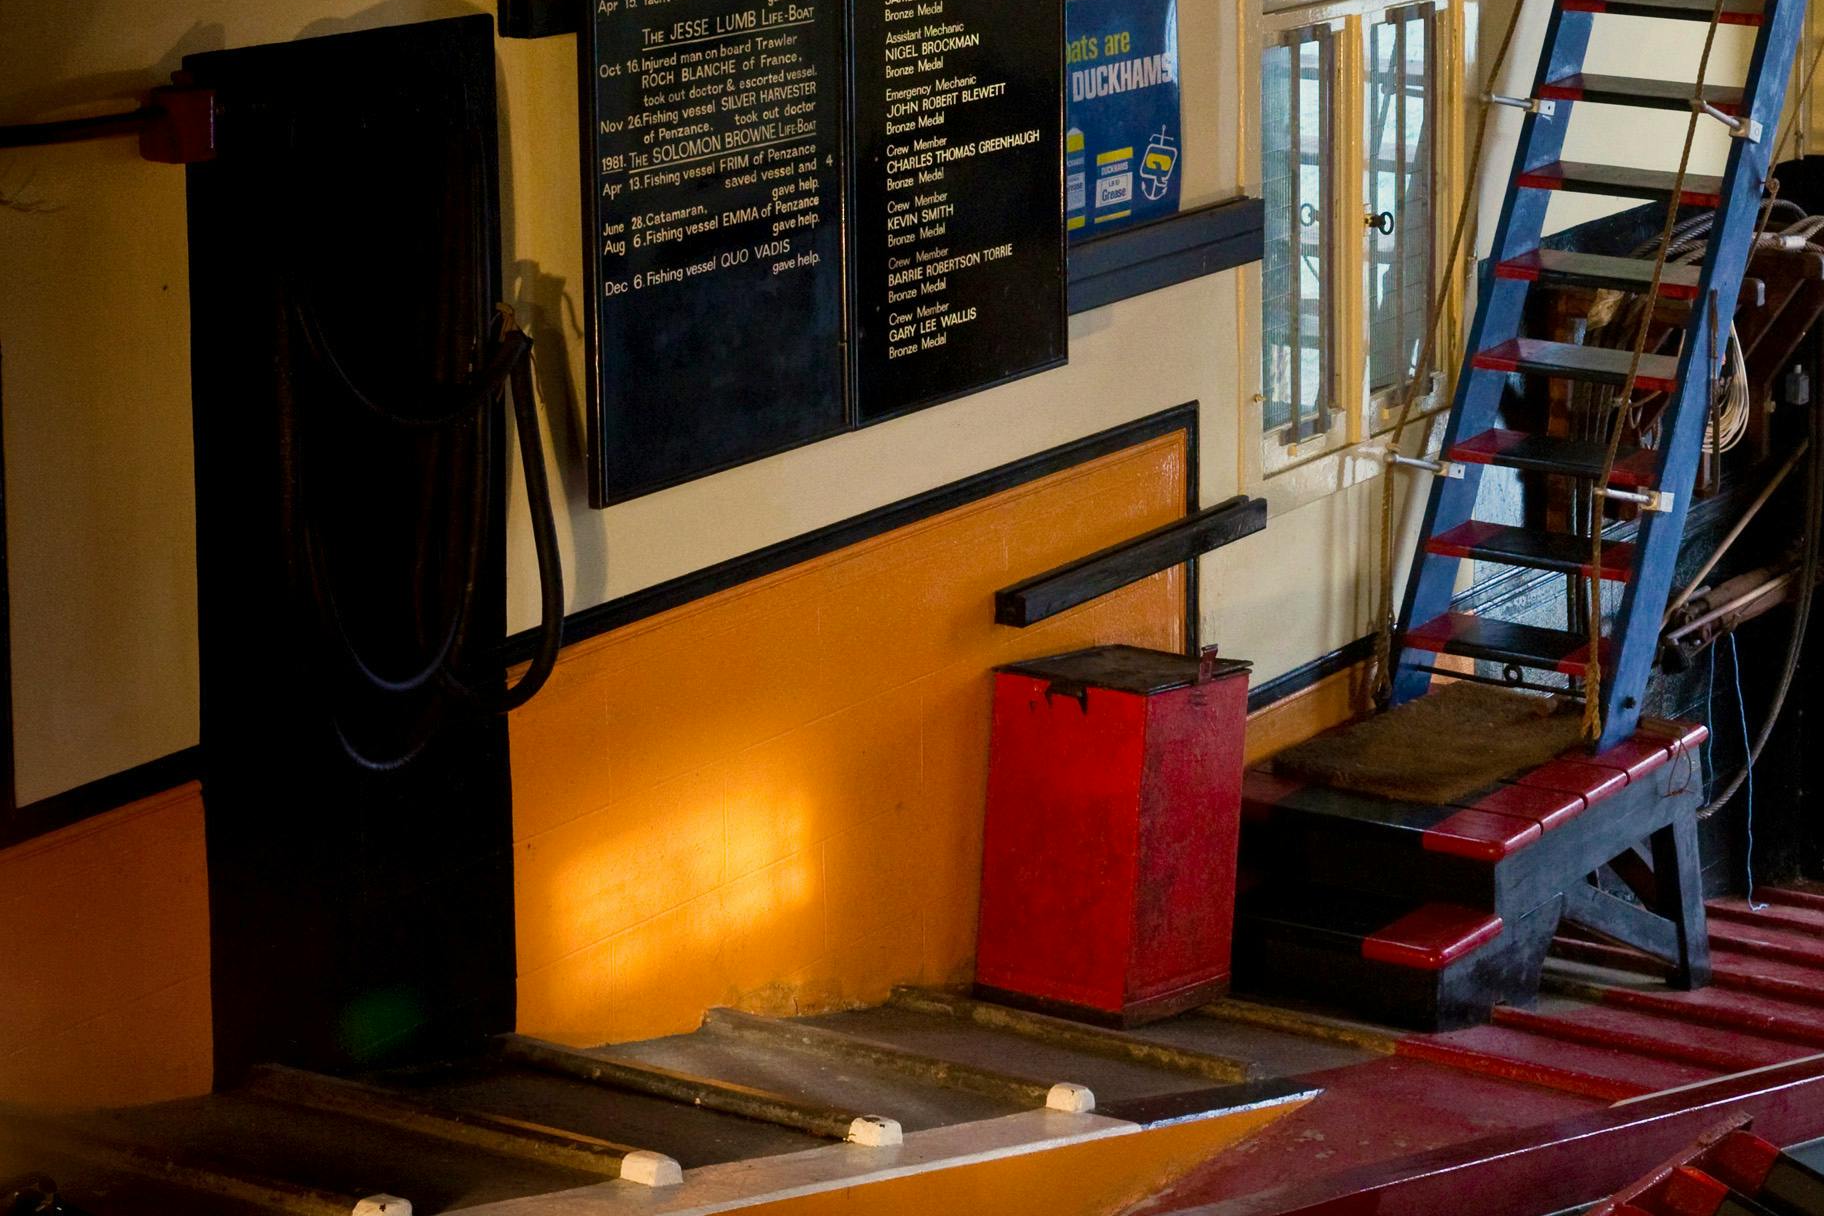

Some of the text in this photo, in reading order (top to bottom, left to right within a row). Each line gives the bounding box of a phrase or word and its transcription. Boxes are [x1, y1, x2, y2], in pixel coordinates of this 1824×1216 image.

[599, 0, 618, 16] Apr
[885, 1, 942, 21] Bronze Medal
[670, 11, 756, 40] JESSE LUMB
[886, 21, 964, 44] Assistant Mechanic
[600, 34, 797, 78] Oct Injured board Trawler
[885, 34, 979, 61] NIGEL BROCKMAN
[1105, 32, 1130, 56] are
[642, 60, 736, 89] ROCH BLANCHE
[886, 74, 976, 101] Emergency Mechanic
[1073, 52, 1174, 102] DUCKHAMS
[644, 73, 784, 107] took doctor escorted
[887, 83, 1006, 118] JOHN ROBERT BLEWETT
[601, 82, 816, 134] Nov Fishing vessel SILVER HARVESTER
[735, 100, 816, 125] took doctor
[653, 125, 776, 164] SOLOMON BROWNE
[914, 136, 947, 151] Member
[644, 144, 816, 189] Fishing vessel FRIM Penzance
[887, 143, 975, 174] CHARLES THOMAS
[725, 166, 794, 189] saved vessel
[915, 192, 947, 207] Member
[1102, 189, 1126, 201] Grease
[604, 196, 819, 255] Aug Fishing vessel EMMA Penzance
[888, 204, 953, 230] KEVIN SMITH
[605, 240, 790, 296] Dec Fishing vessel QUO VADIS
[889, 244, 1013, 286] BARRIE ROBERTSON TORRIE
[916, 248, 949, 262] Member
[917, 302, 949, 317] Member
[889, 307, 976, 342] GARY LEE WALLIS
